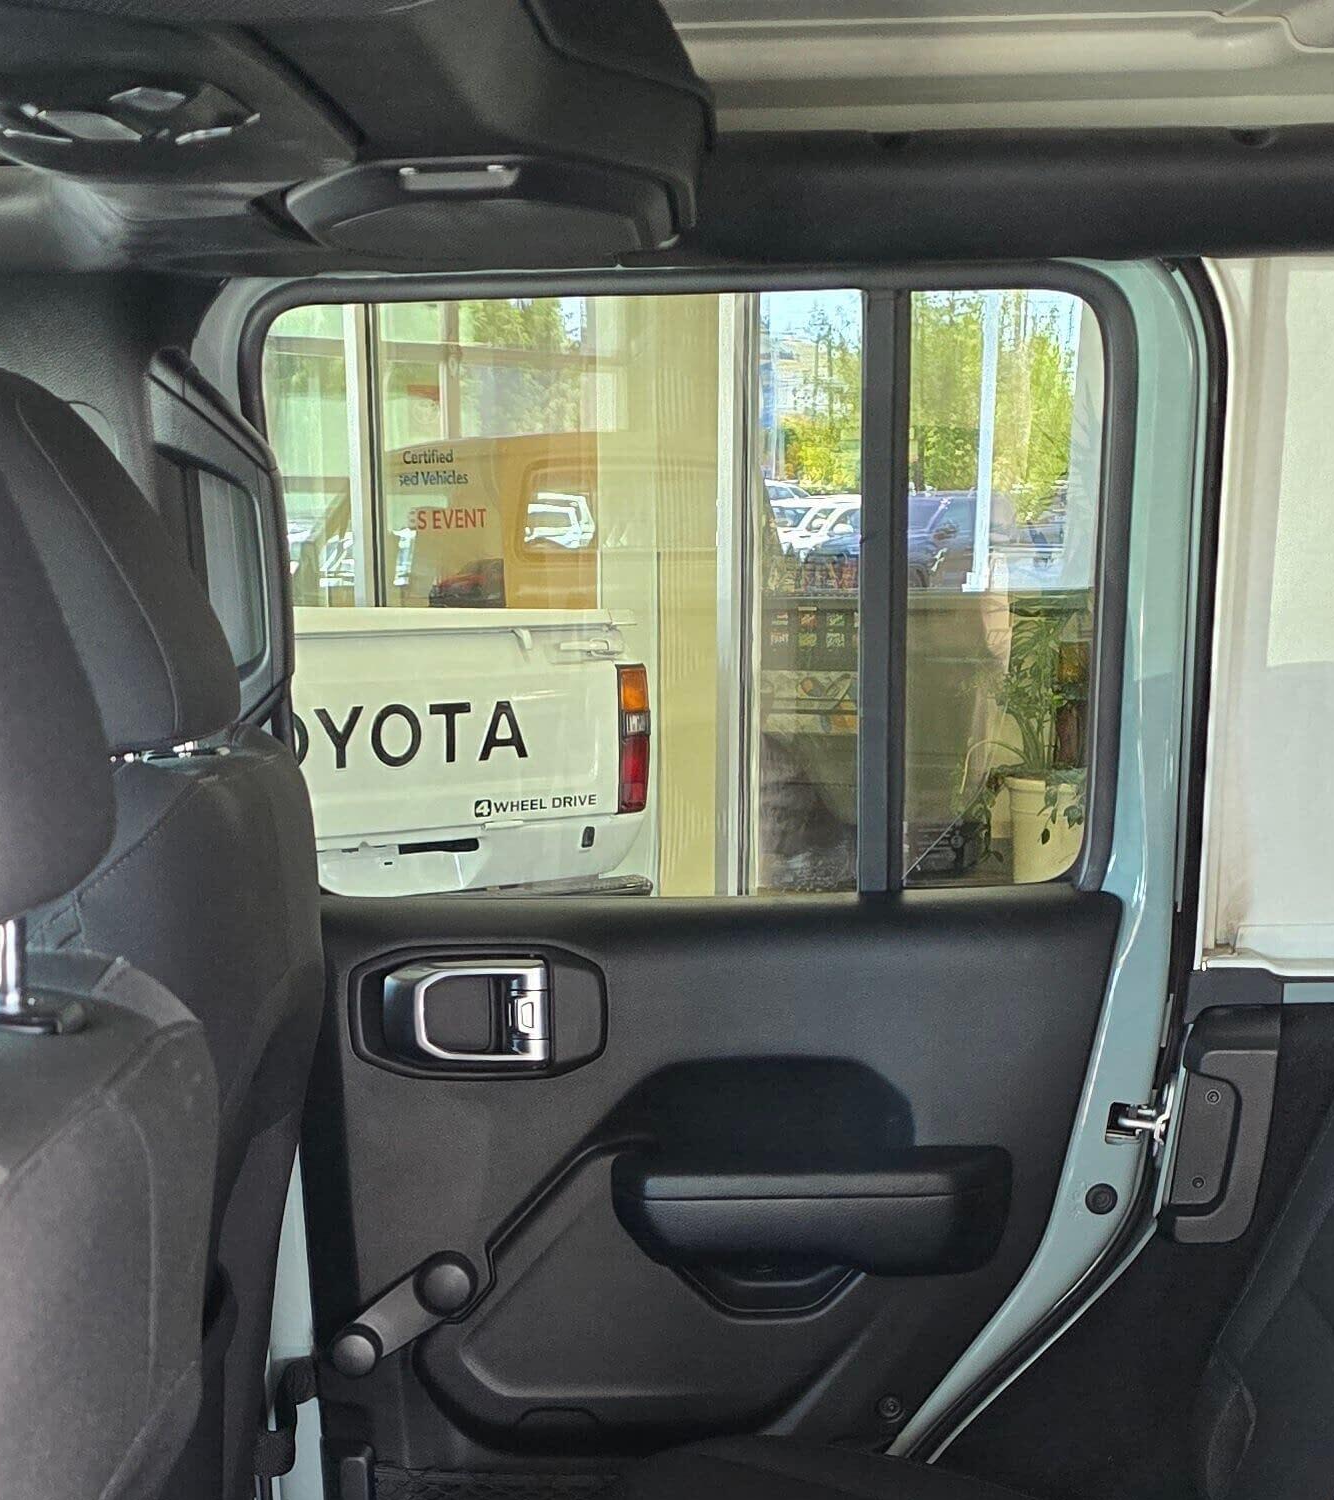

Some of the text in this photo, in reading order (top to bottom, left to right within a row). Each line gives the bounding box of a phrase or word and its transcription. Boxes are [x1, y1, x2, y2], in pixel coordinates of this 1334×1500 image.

[402, 449, 453, 464] Certified
[421, 469, 468, 485] Vehicles
[432, 508, 486, 530] EVENT
[293, 700, 529, 769] YOTA
[551, 794, 597, 809] DRIVE
